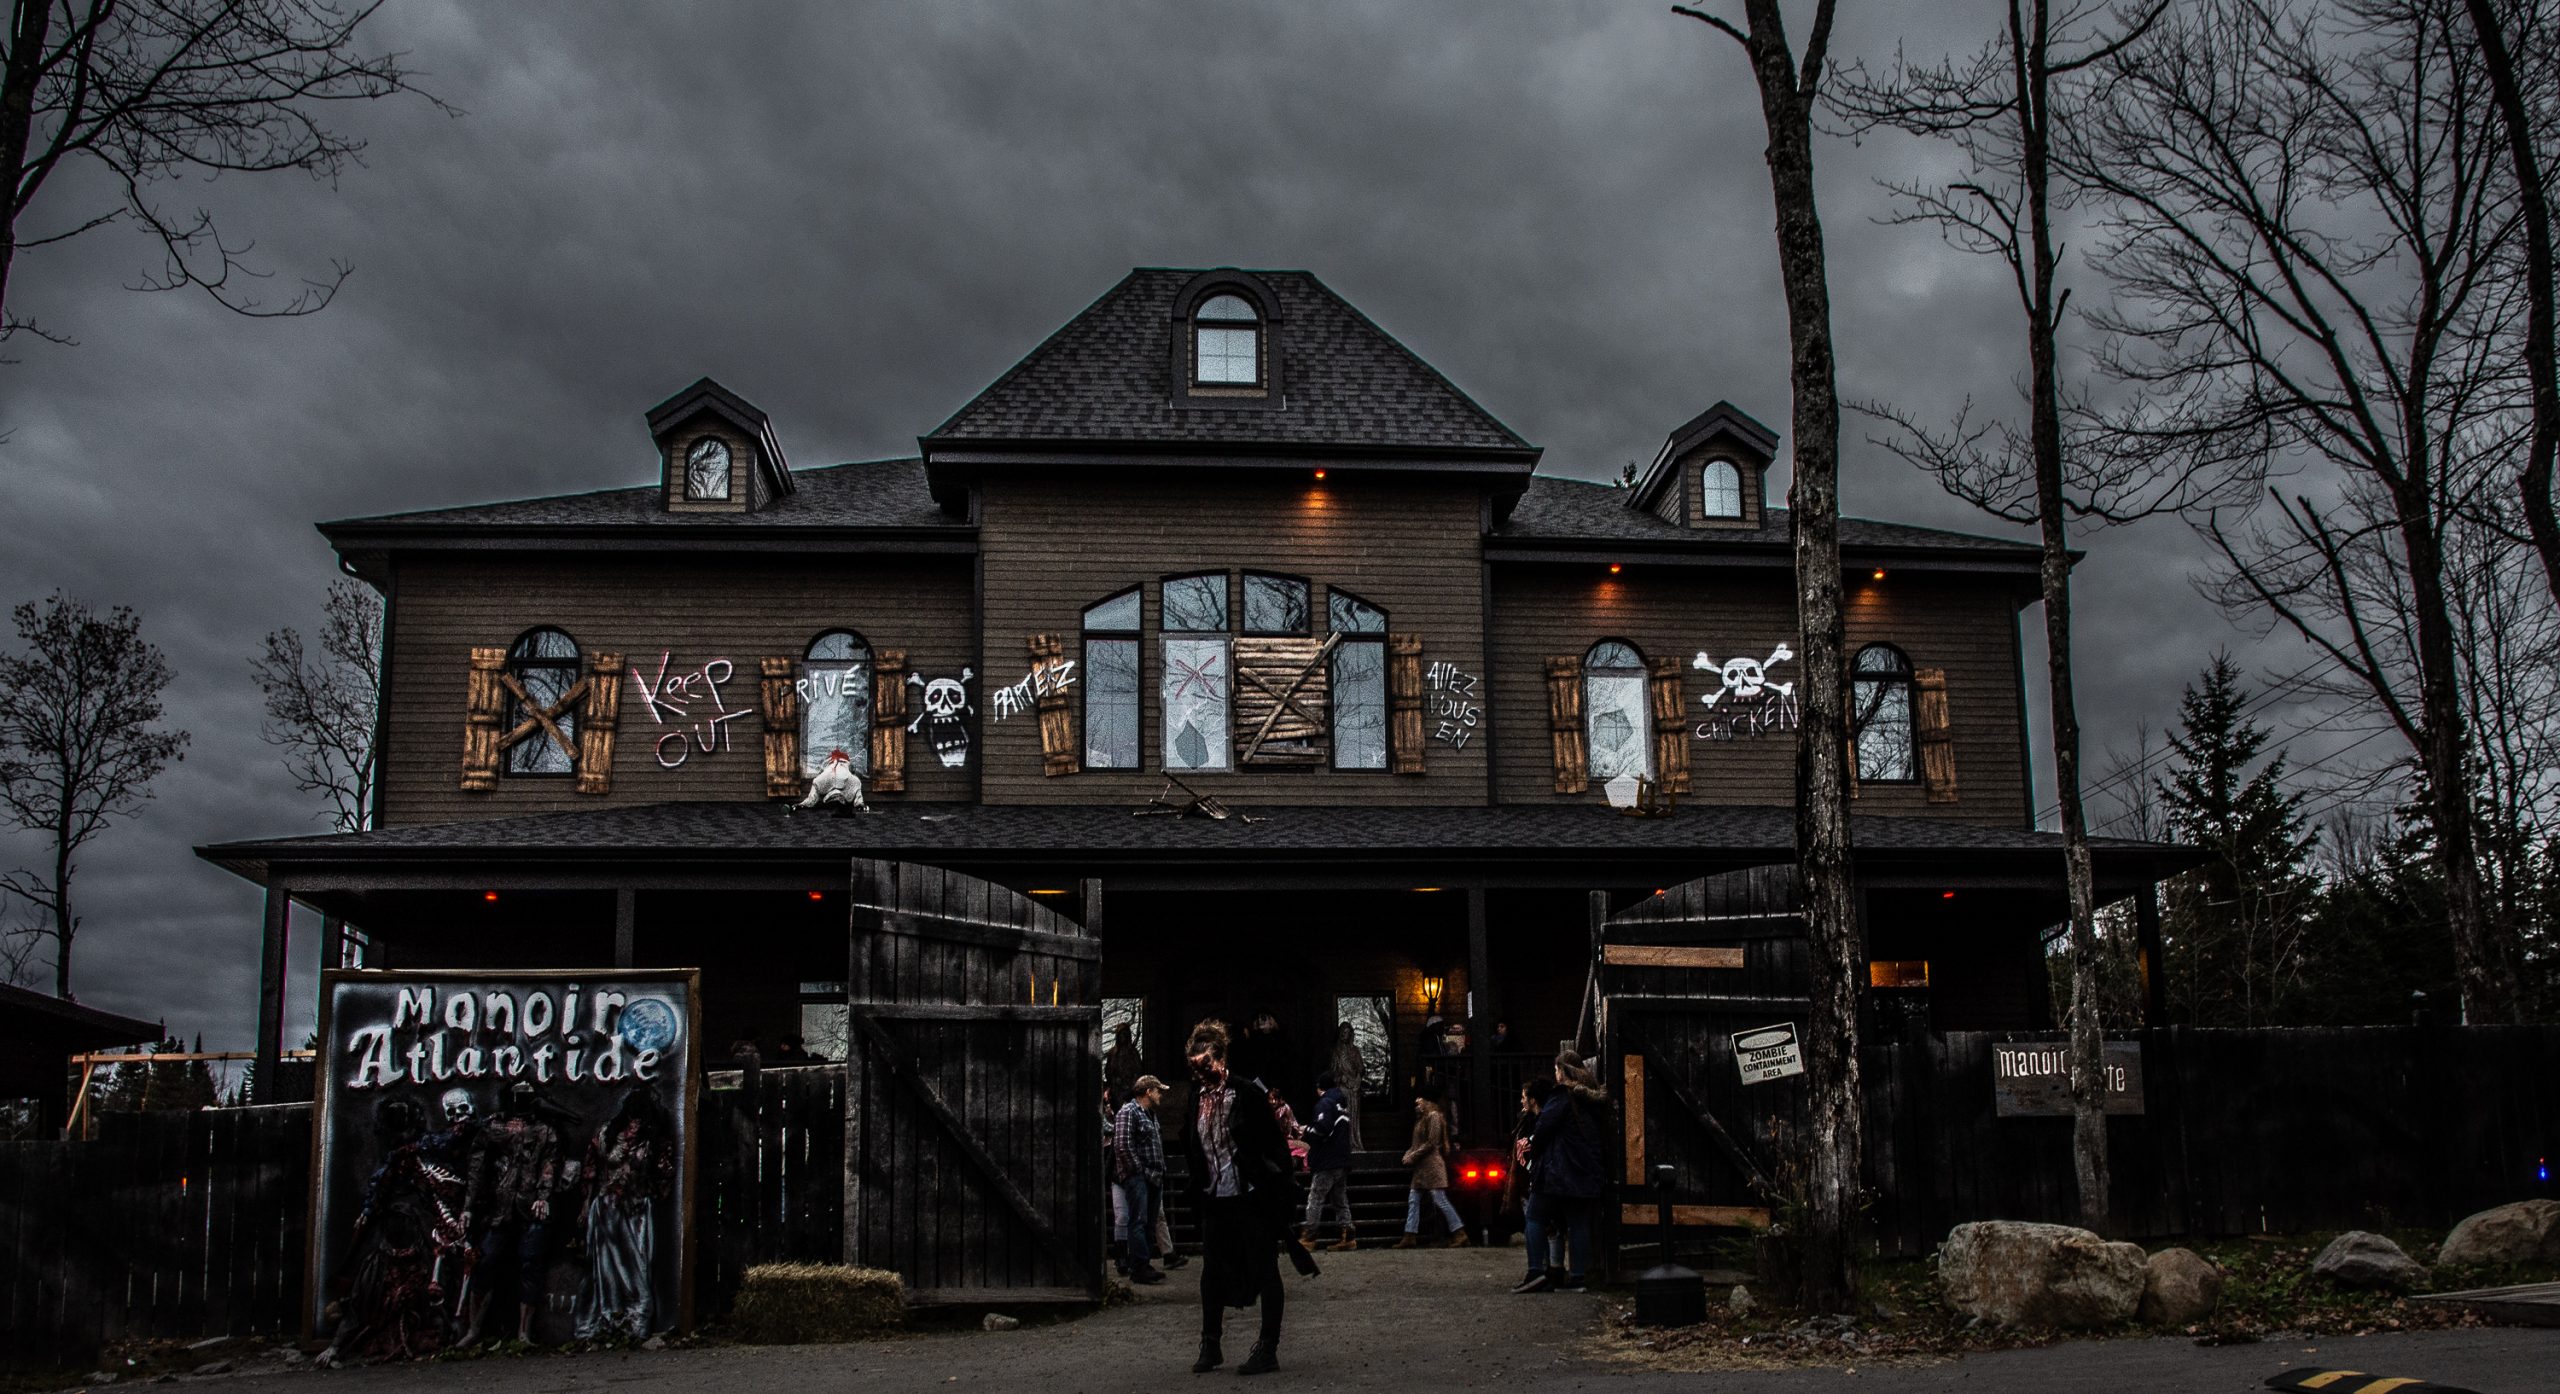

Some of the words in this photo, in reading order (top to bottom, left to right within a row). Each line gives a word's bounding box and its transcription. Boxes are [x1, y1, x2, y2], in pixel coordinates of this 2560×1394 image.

[993, 660, 1076, 723] PARTEZ
[1429, 694, 1481, 727] VOUS
[656, 709, 752, 769] OUT
[1435, 720, 1471, 751] EN
[395, 984, 625, 1037] Manoir
[348, 1026, 661, 1087] Atlantide
[1743, 1055, 1796, 1072] CONTAINMENT
[1750, 1046, 1787, 1062] ZOMBIE
[1762, 1069, 1782, 1078] AREA
